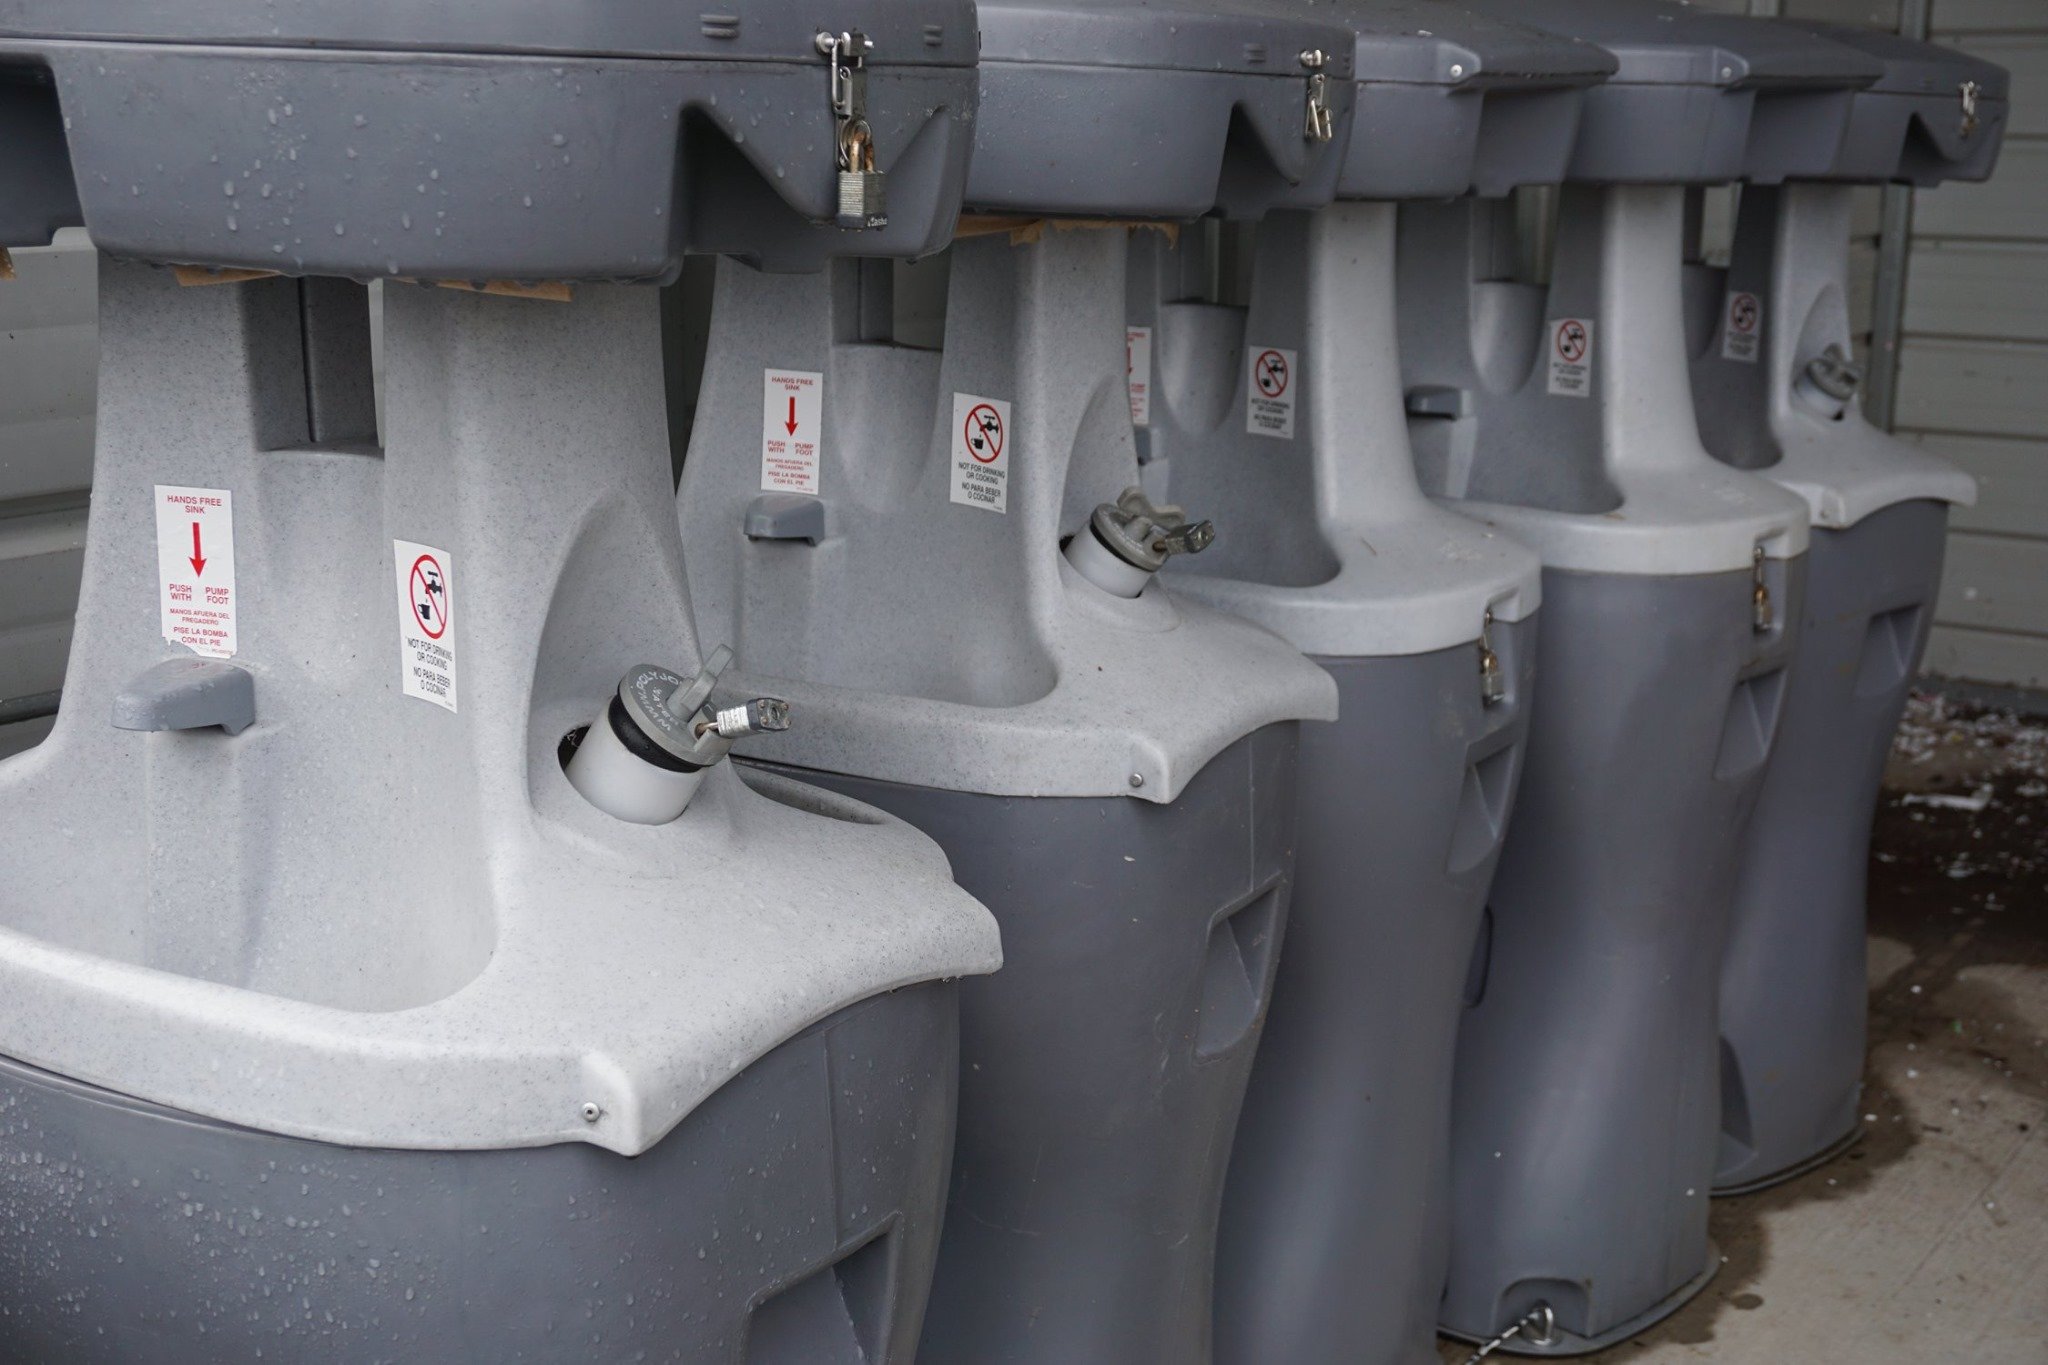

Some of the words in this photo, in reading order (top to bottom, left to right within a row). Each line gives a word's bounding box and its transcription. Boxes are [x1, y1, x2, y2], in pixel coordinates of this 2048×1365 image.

[772, 376, 795, 384] HANDS
[796, 378, 814, 386] FREE
[959, 462, 970, 470] NOT
[971, 464, 981, 472] FOR
[983, 466, 1005, 479] DRINKING
[966, 471, 974, 479] OR
[975, 473, 998, 485] COOKING
[962, 482, 970, 490] NO
[971, 483, 984, 492] PARA
[985, 487, 1001, 498] BEBER
[167, 495, 197, 505] HANDS
[200, 497, 222, 506] FREE
[973, 492, 995, 503] COCINAR
[185, 505, 205, 514] SINK
[169, 583, 192, 593] PUSH
[205, 587, 229, 596] PUMP
[171, 593, 192, 601] WITH
[207, 596, 229, 605] FOOT
[170, 608, 192, 616] MANOS
[194, 610, 217, 618] AFUERA
[182, 617, 219, 626] FREGADERO
[203, 629, 228, 638] BOMBA
[408, 638, 419, 649] NOT
[421, 641, 431, 652] FOR
[433, 644, 453, 662] DRINKING
[417, 651, 425, 662] OR
[426, 654, 447, 670] COOKING
[414, 666, 421, 677] NO
[423, 669, 436, 681] PARA
[437, 673, 450, 688] BEBER
[426, 681, 446, 697] COCINAR
